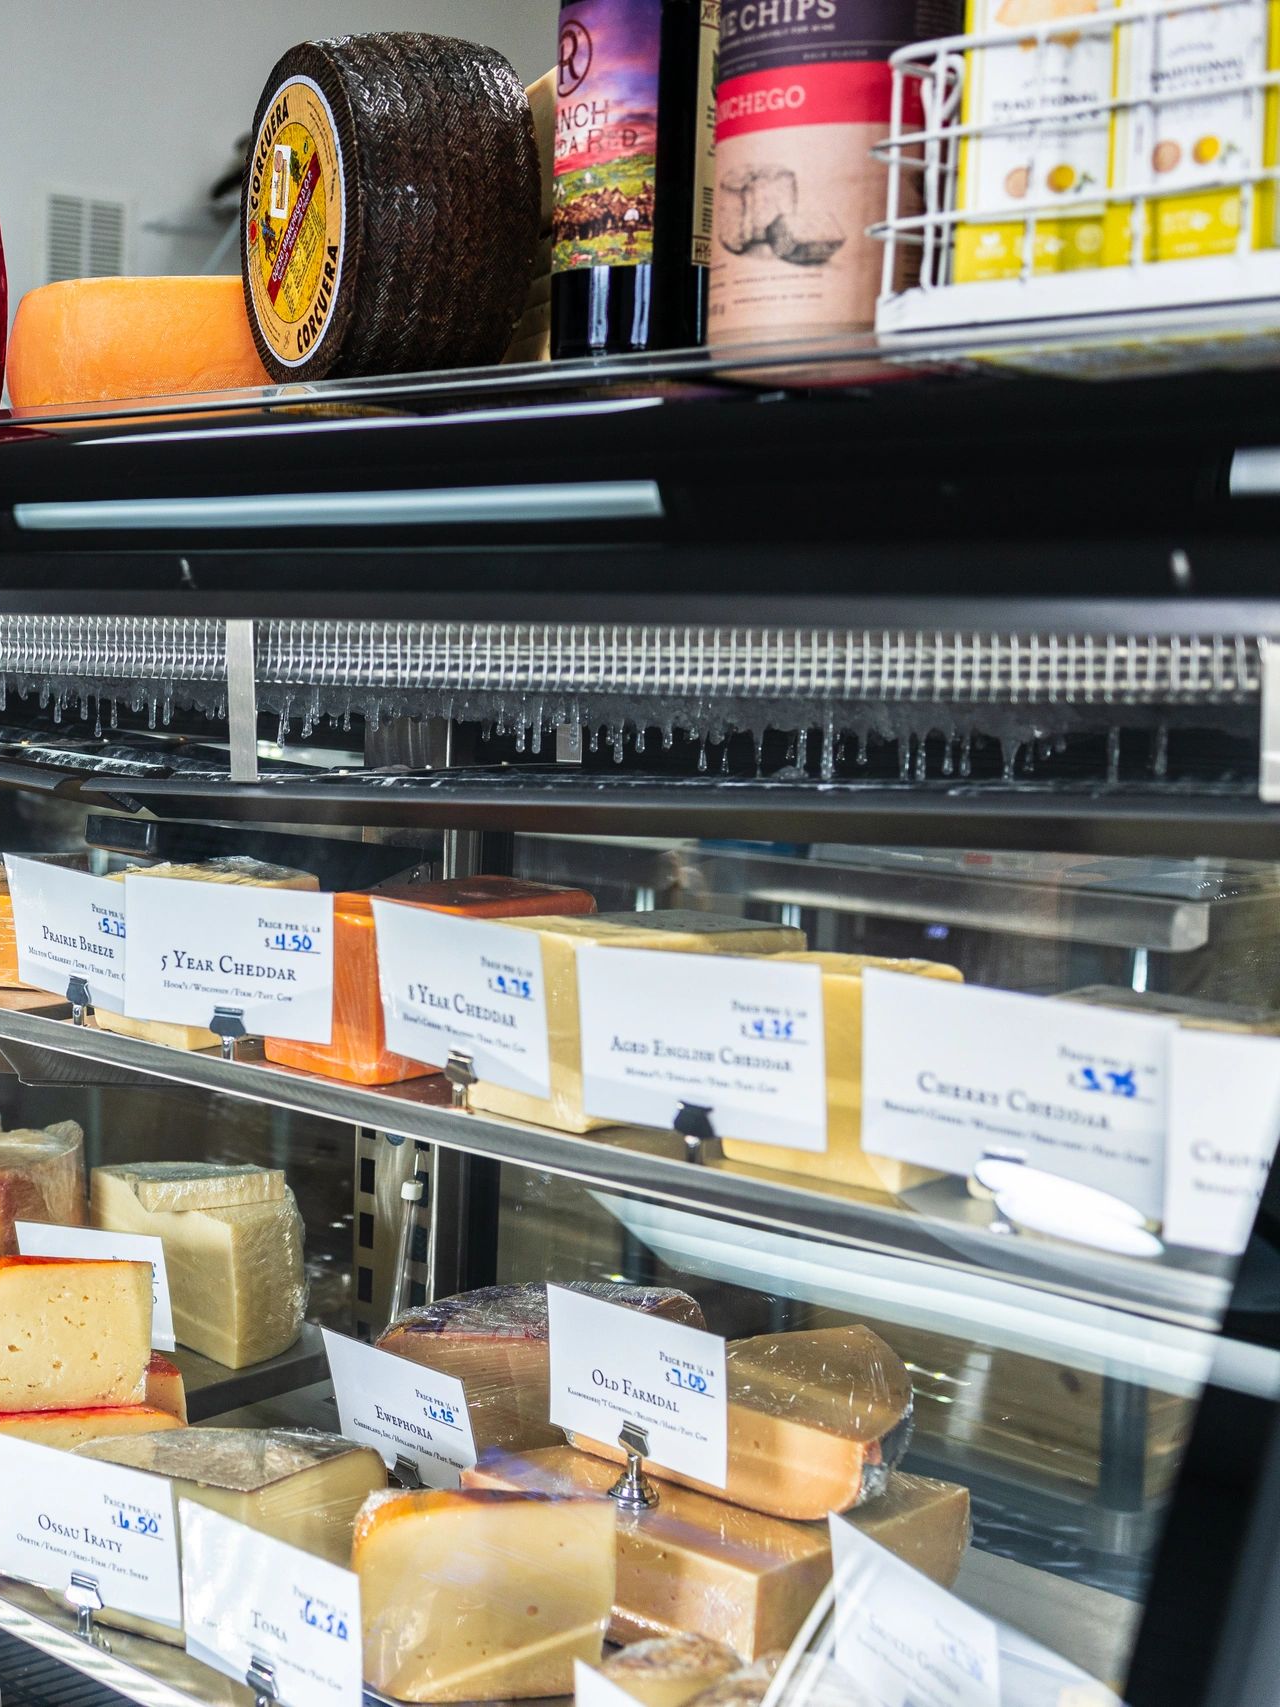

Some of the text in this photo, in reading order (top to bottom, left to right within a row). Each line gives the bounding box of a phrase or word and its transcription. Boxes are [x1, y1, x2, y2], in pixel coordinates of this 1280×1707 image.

[740, 0, 837, 31] CHIPS
[555, 99, 610, 134] ANCH
[718, 84, 805, 120] NCHEGO
[251, 97, 290, 211] CORCUERA
[282, 193, 304, 251] MANCHEGO
[296, 245, 339, 354] CORCUERA
[92, 904, 118, 919] PRICE PER
[257, 918, 282, 931] PRICE
[285, 922, 300, 932] PER
[42, 925, 115, 959] PRAIRIE BREEZE
[264, 934, 313, 952] $4.50
[161, 950, 297, 982] 5 YEAR CHEDDAR
[418, 984, 517, 1029] YEAR CHEDDAR
[611, 1035, 793, 1072] AGED ENGLISH CHEDDAR
[917, 1071, 1111, 1130] CHERRY CHEDDAR
[659, 1350, 680, 1367] PRICE
[682, 1360, 695, 1371] PER
[592, 1368, 680, 1413] OLD FARMDAL
[665, 1368, 707, 1392] $7.00
[415, 1388, 433, 1403] PRICE
[434, 1398, 444, 1407] PER
[423, 1405, 455, 1424] $6.25
[374, 1404, 433, 1441] EWEPHORIA
[103, 1494, 125, 1509] PRICE
[128, 1503, 141, 1514] PER
[38, 1513, 123, 1553] OSSAU IRATY
[111, 1510, 158, 1534] $6.50
[250, 1608, 288, 1642] TOMA
